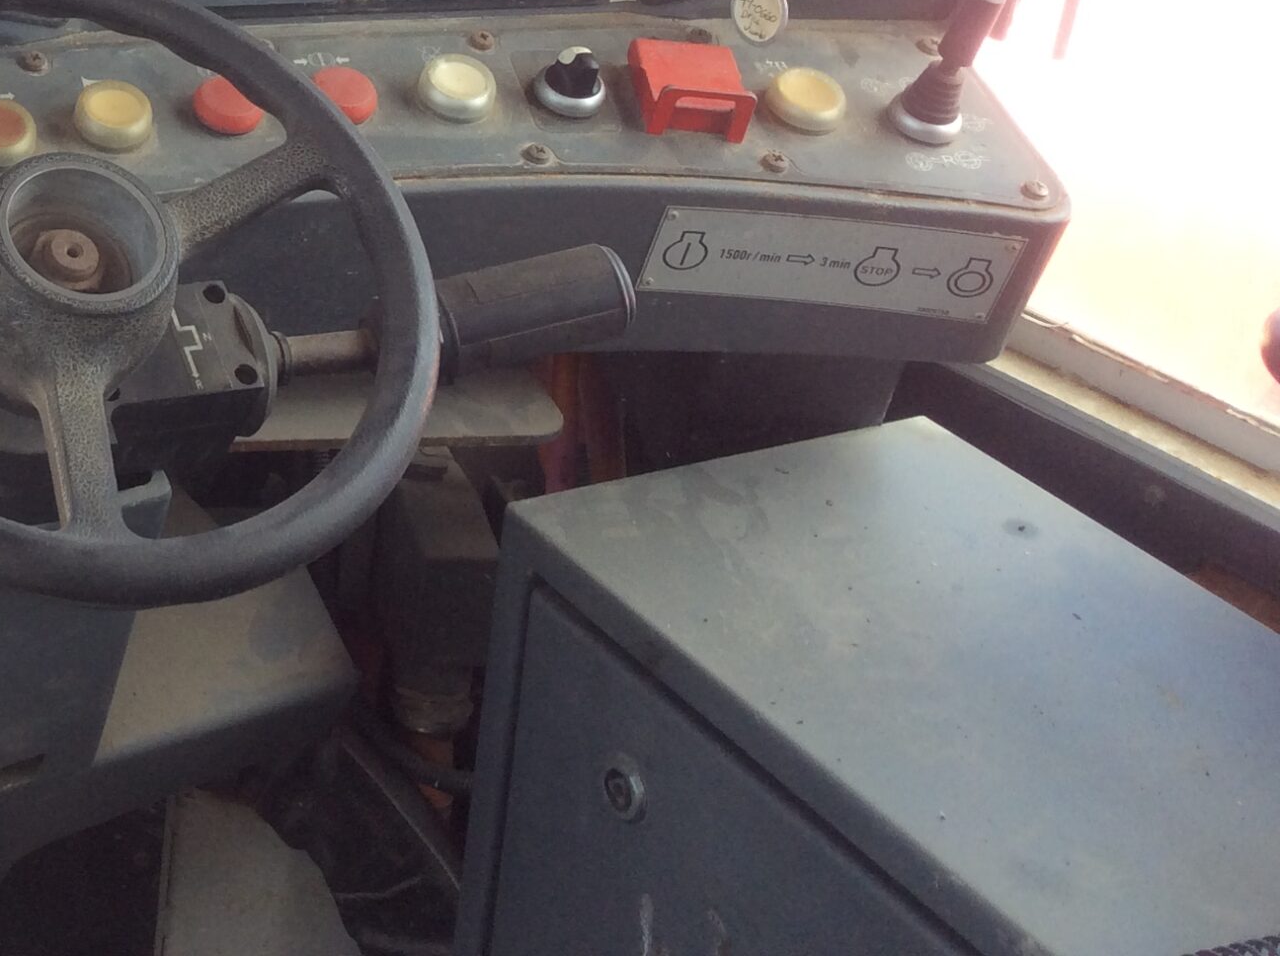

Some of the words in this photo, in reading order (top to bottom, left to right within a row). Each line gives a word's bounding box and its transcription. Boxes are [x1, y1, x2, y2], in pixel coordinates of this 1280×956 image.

[820, 256, 828, 267] 3
[829, 258, 851, 269] min
[860, 265, 893, 276] STOP
